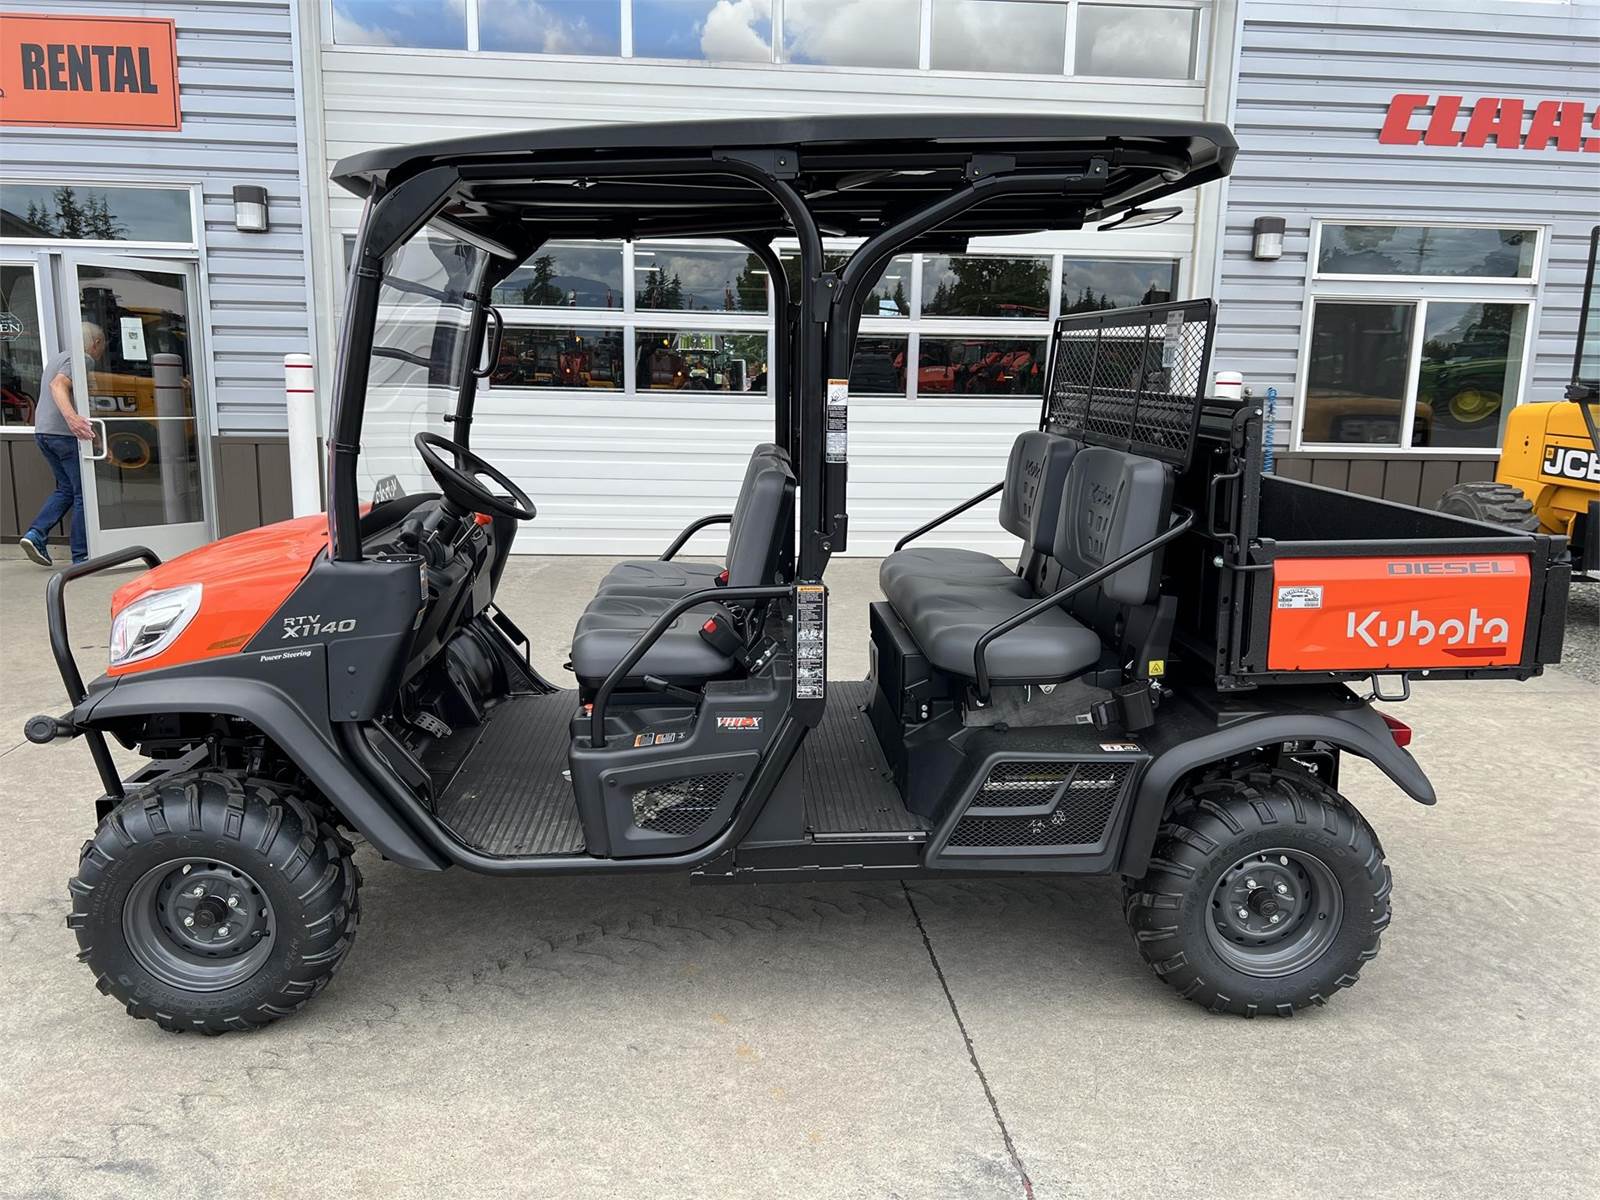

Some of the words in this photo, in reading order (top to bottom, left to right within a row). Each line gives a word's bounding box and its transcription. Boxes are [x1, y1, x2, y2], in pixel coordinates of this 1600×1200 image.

[21, 43, 158, 94] RENTAL
[1387, 561, 1514, 576] DIESEL
[281, 619, 357, 639] X1140
[283, 614, 321, 627] RTV
[1347, 608, 1509, 648] Kubota
[260, 654, 282, 662] Power
[282, 650, 312, 659] Steering
